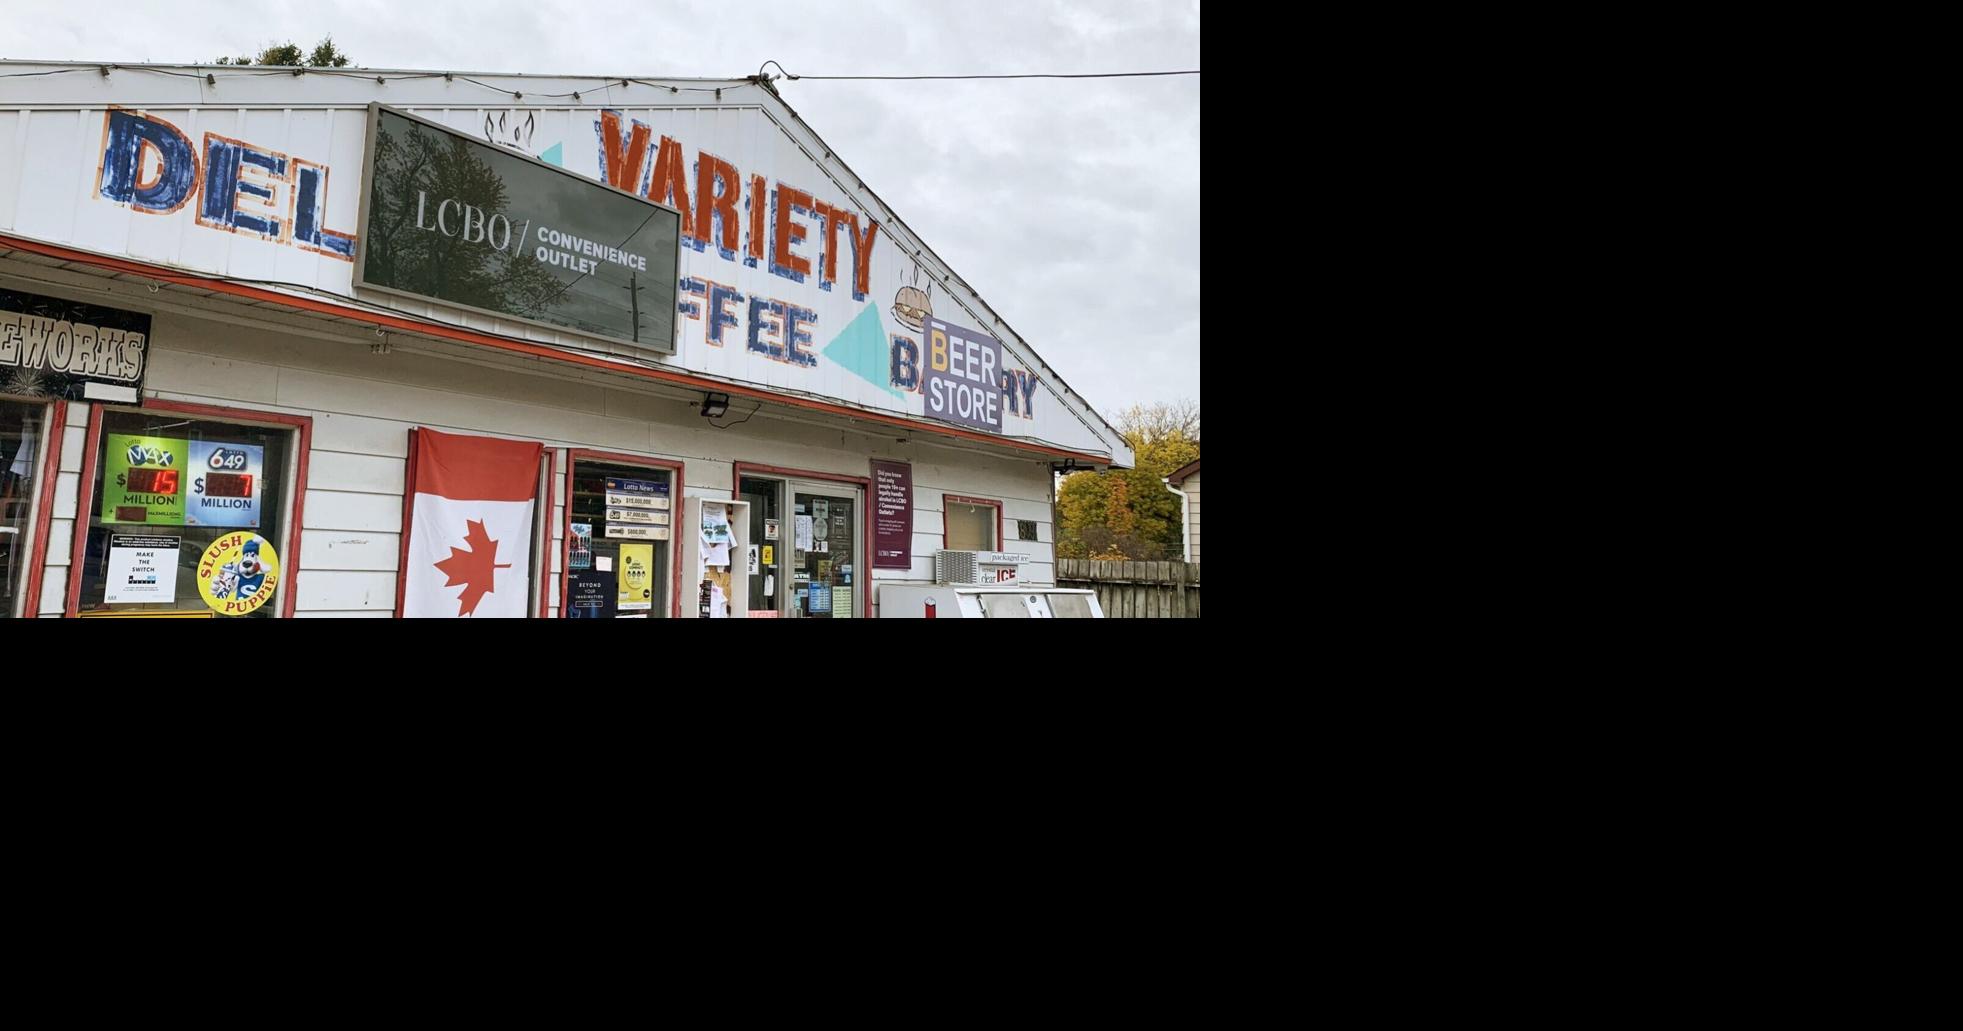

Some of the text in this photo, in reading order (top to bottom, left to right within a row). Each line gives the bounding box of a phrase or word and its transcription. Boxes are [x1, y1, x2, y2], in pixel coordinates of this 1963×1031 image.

[596, 109, 879, 301] VARIETY
[416, 190, 511, 252] LCBO
[537, 226, 647, 272] CONVENIENCE
[536, 246, 598, 276] OUTLET
[931, 327, 997, 387] BEER
[930, 376, 998, 425] STORE
[127, 445, 172, 466] MAX
[116, 470, 177, 494] $ 15
[194, 474, 250, 496] $ 7
[639, 484, 654, 492] News
[123, 495, 175, 506] MILLION
[201, 498, 252, 509] MILLION
[200, 535, 242, 578] SLUSH
[991, 554, 1020, 562] packaged
[981, 568, 1016, 583] clear ICE
